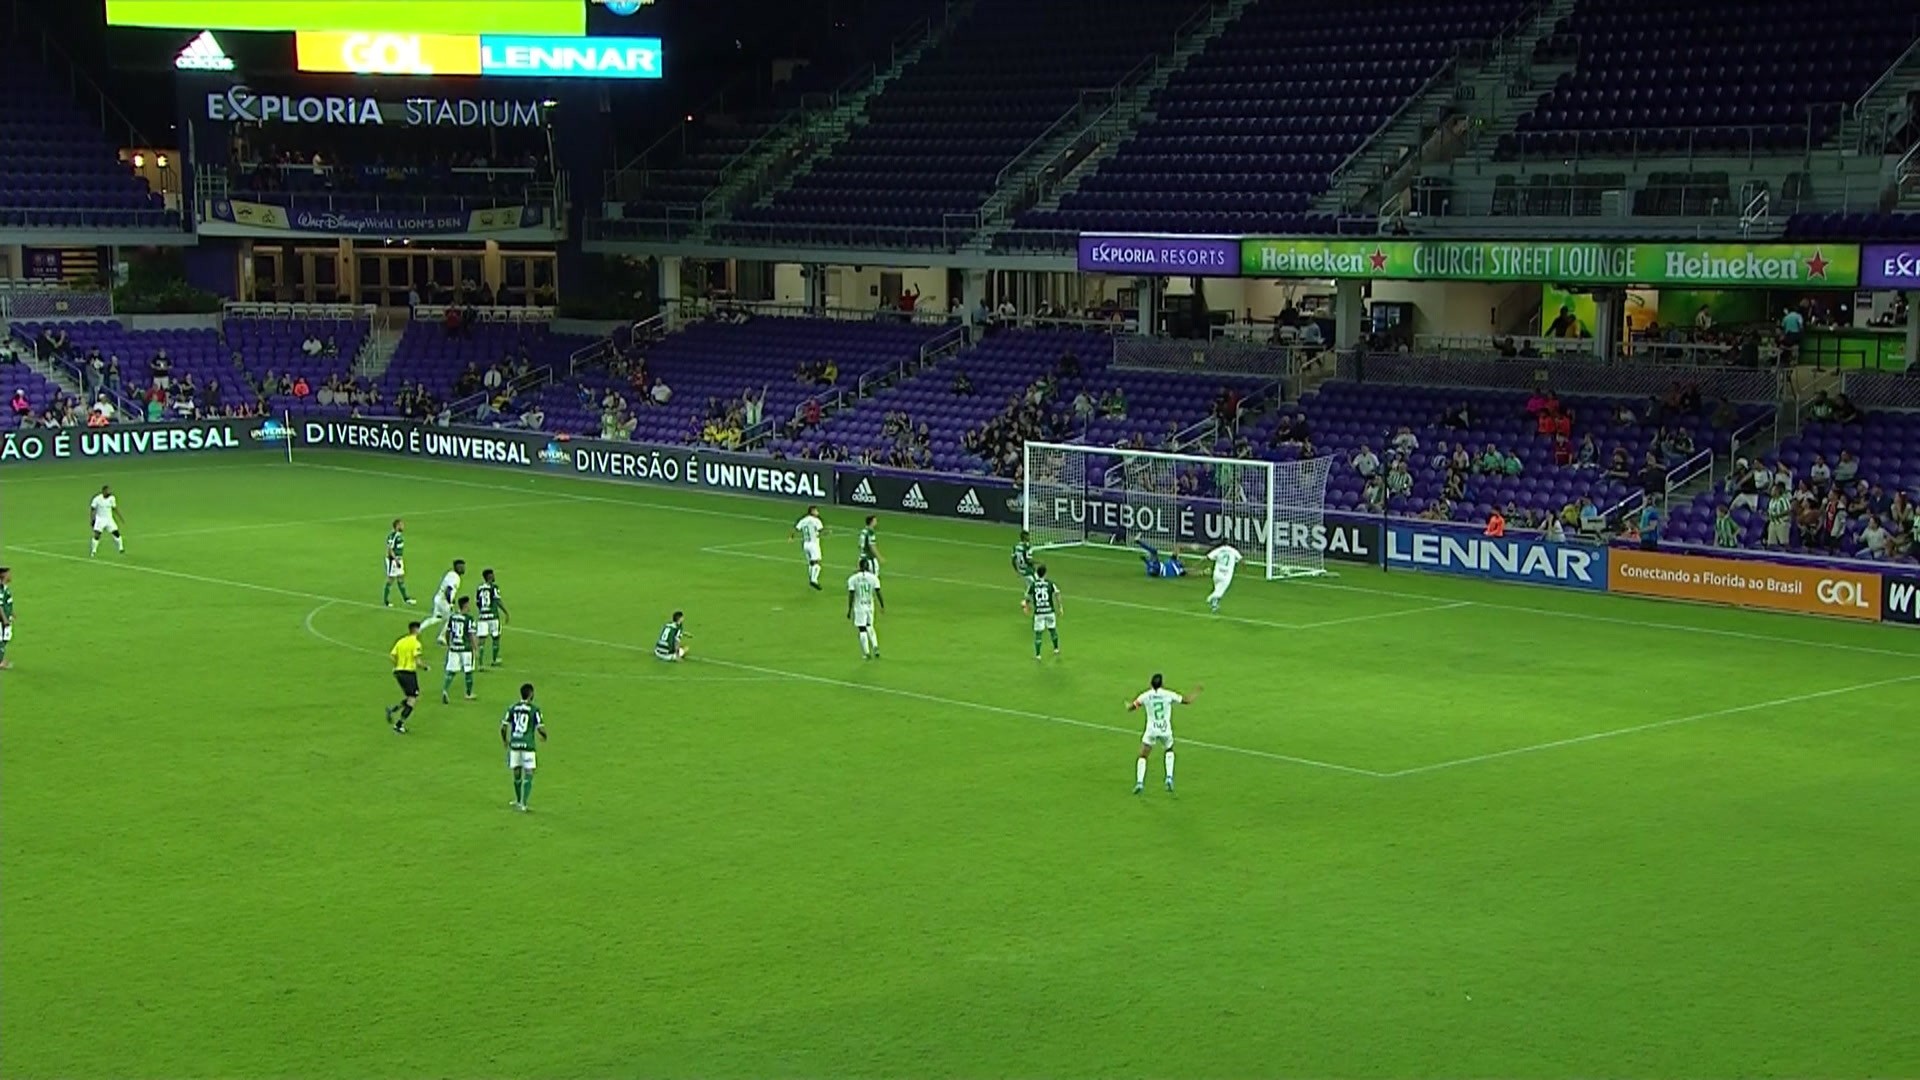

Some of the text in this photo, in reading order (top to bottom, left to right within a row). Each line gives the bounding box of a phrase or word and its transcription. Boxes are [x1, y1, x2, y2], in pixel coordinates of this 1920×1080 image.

[342, 34, 433, 75] GOL
[482, 45, 656, 71] LENNAR
[207, 85, 541, 127] EXPLORIA STADIUM
[365, 217, 394, 229] World
[397, 219, 434, 229] LION'S
[438, 218, 461, 228] DEN
[1091, 243, 1225, 265] EXPLORIA RESORTS
[1261, 247, 1364, 273] Heineken
[1412, 246, 1636, 277] CHURCH STREET LOUNGE
[1665, 251, 1799, 280] Heineken
[0, 427, 239, 461] ÃO É UNIVERSAL
[306, 423, 531, 464] DIVERSÃO É UNIVERSAL
[576, 450, 826, 498] DIVERSÃO É UNIVERSAL
[851, 493, 877, 504] adidas
[902, 499, 929, 510] adidas
[956, 504, 985, 515] adidas
[1053, 497, 1369, 555] FUTEBOL É UNIVERSAL
[1386, 531, 1593, 583] LENNAR
[1620, 563, 1802, 595] Conectando a Florida ao Brasil
[1816, 579, 1869, 608] GOL
[1153, 701, 1164, 720] 2
